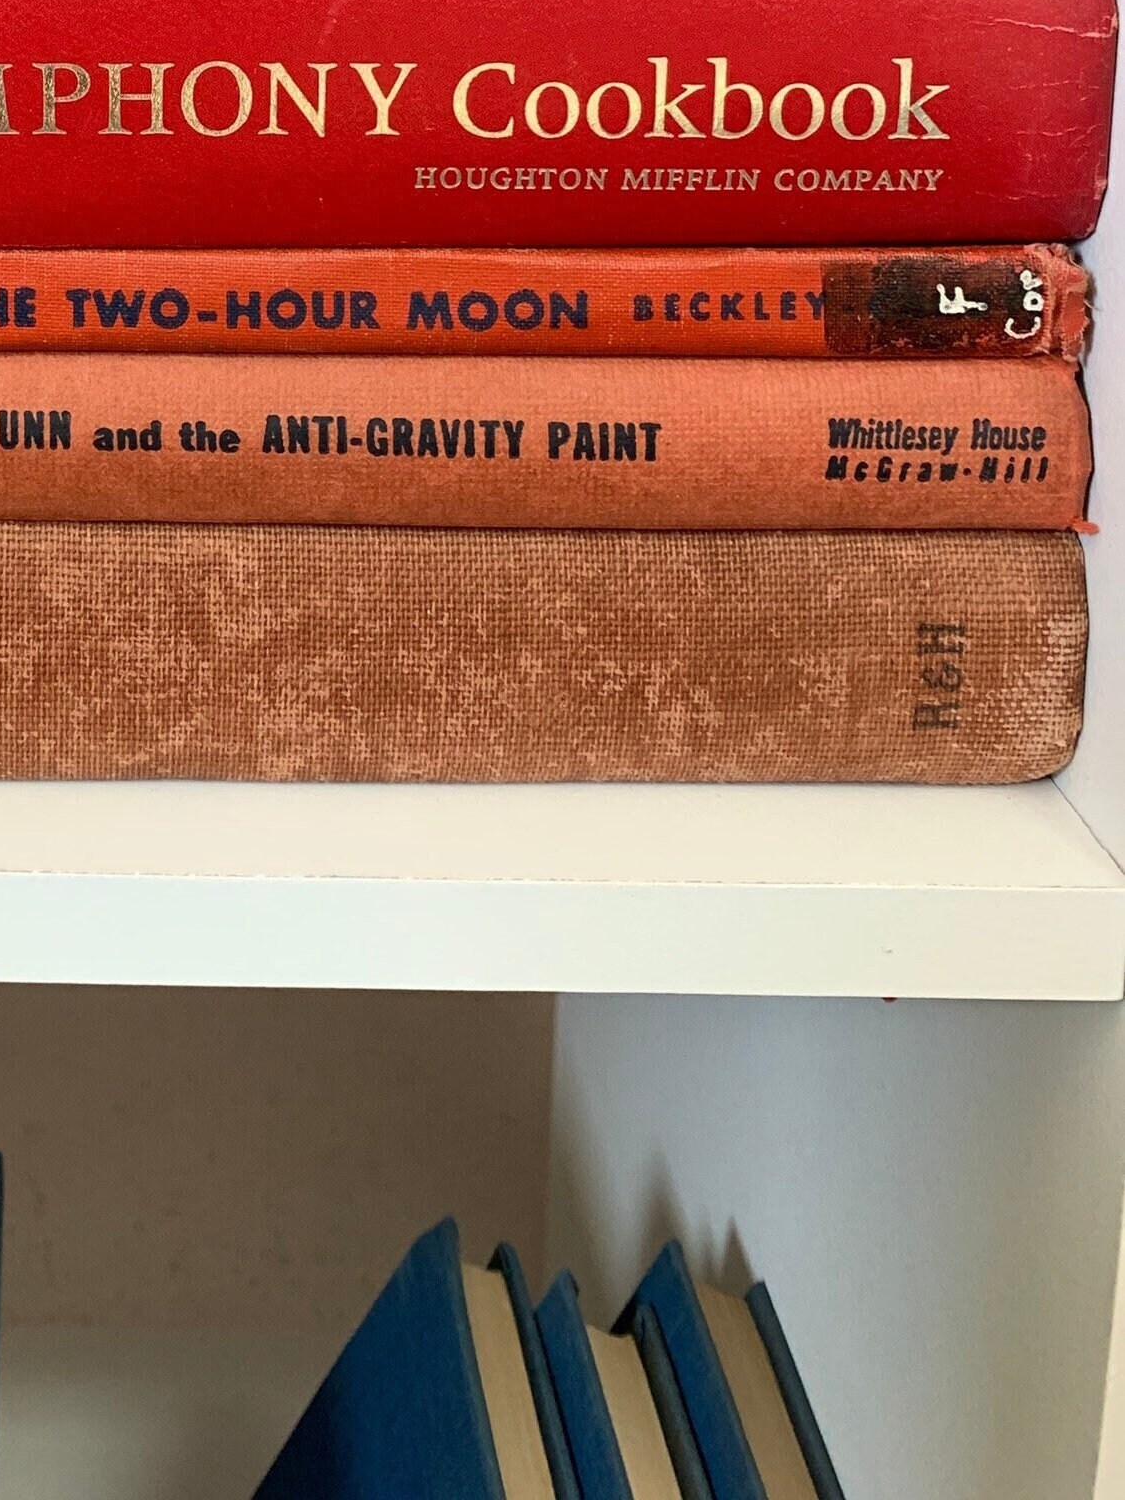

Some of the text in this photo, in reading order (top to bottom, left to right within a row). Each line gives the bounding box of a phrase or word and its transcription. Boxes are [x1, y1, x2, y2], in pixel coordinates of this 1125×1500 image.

[452, 56, 951, 140] Cookbook
[414, 166, 946, 193] HOUGHTON MIFFLIN COMPANY
[65, 287, 381, 331] TWO-HOUR
[406, 288, 590, 332] MOON
[632, 291, 826, 322] BECKLEY
[935, 283, 989, 314] F
[91, 420, 163, 454] and
[178, 419, 242, 454] the
[260, 414, 525, 460] ANTI-GRAVITY
[546, 419, 663, 463] PAINT
[826, 416, 1048, 457] Whittlesey House
